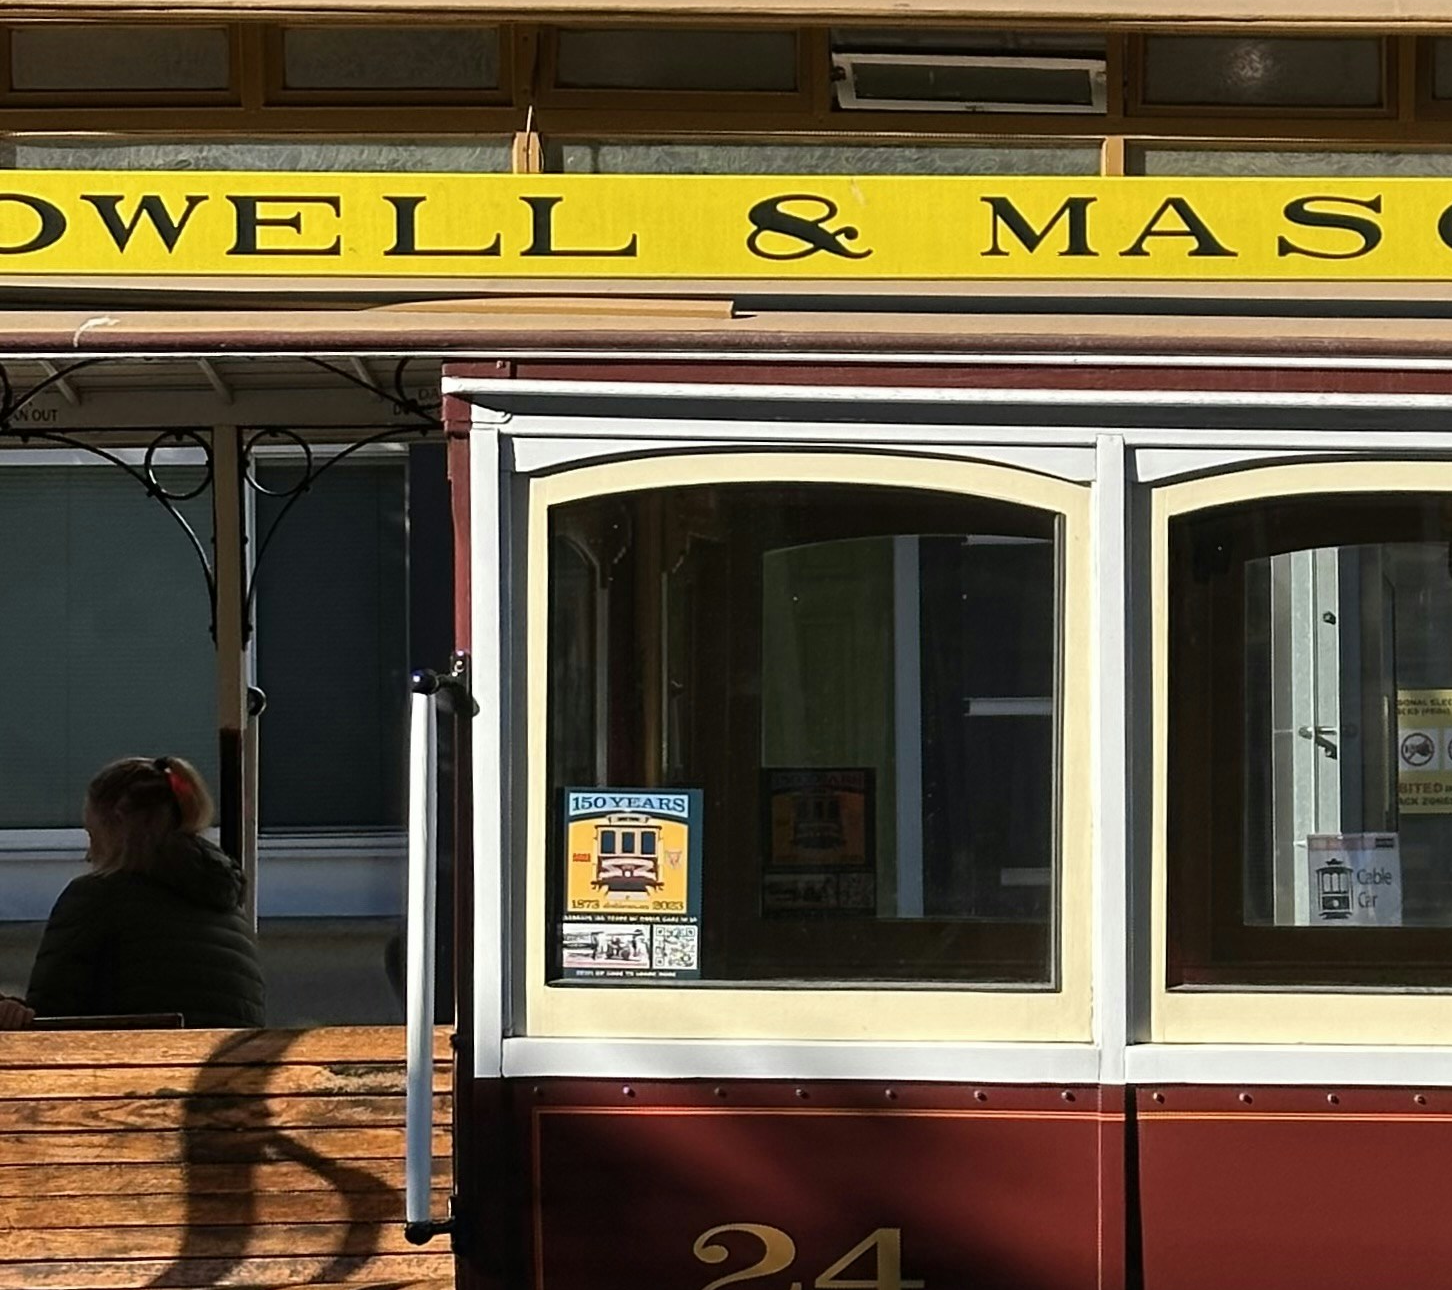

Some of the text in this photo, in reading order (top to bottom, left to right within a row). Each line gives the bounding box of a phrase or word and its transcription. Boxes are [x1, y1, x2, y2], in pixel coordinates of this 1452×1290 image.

[746, 194, 873, 260] &
[32, 409, 57, 421] OUT
[572, 796, 685, 813] 150 YEARS
[1357, 868, 1393, 885] Cable
[571, 899, 600, 910] 1873
[652, 900, 684, 910] 2023
[1358, 892, 1378, 908] Car
